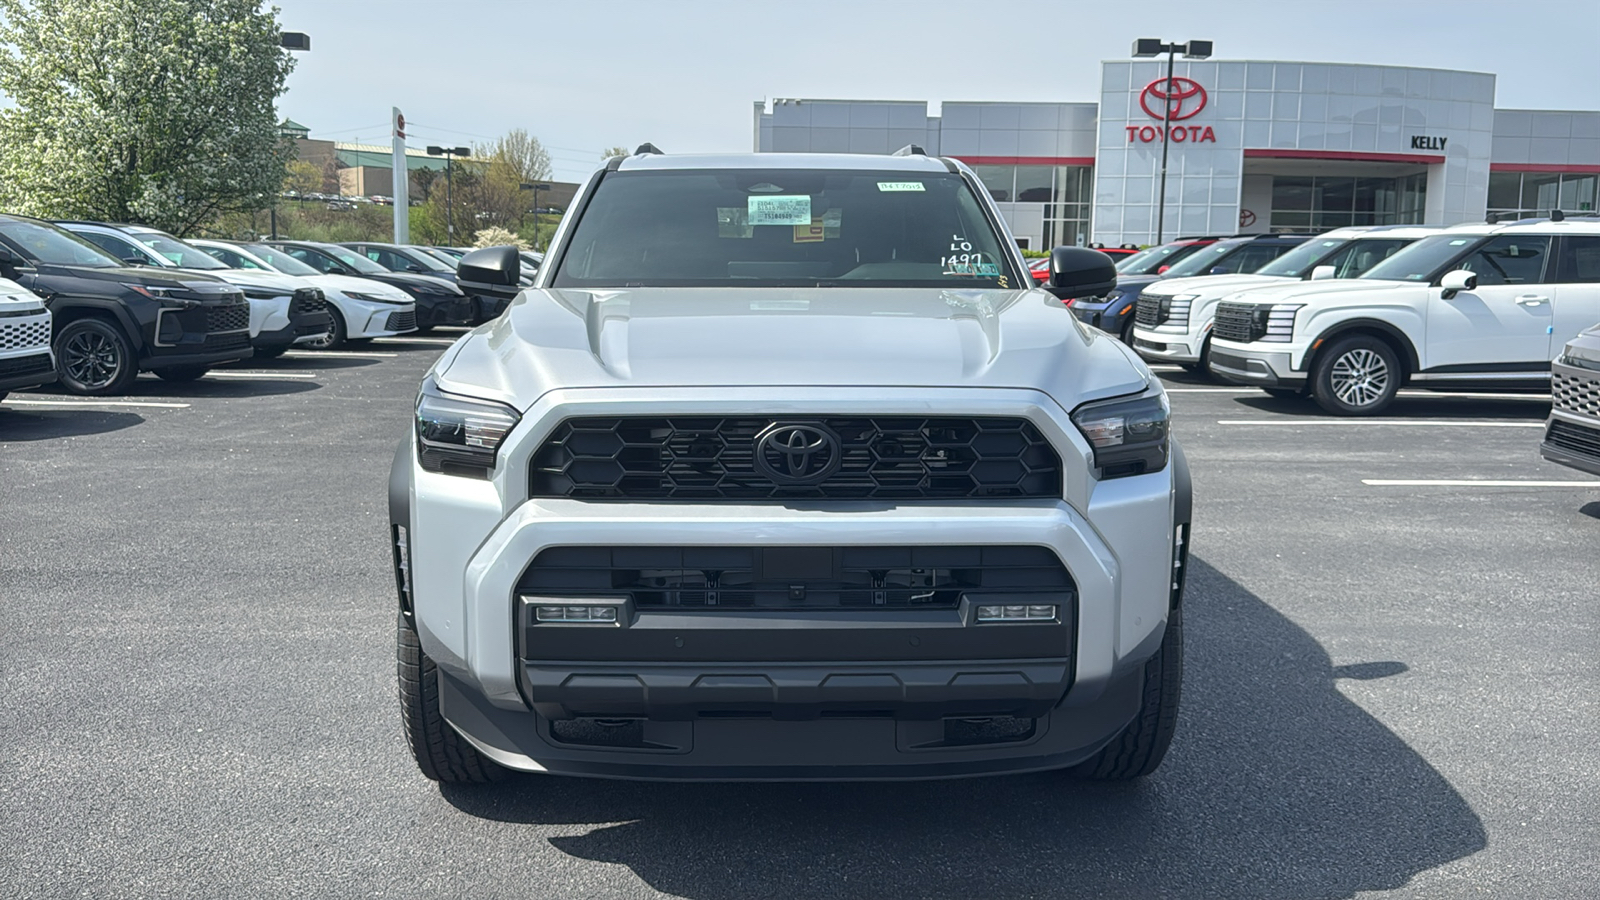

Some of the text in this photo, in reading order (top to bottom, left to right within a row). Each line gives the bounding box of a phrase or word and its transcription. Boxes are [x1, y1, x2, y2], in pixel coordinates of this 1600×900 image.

[1125, 125, 1216, 143] TOYOTA
[1411, 135, 1447, 151] KELLY
[941, 253, 982, 267] 1497
